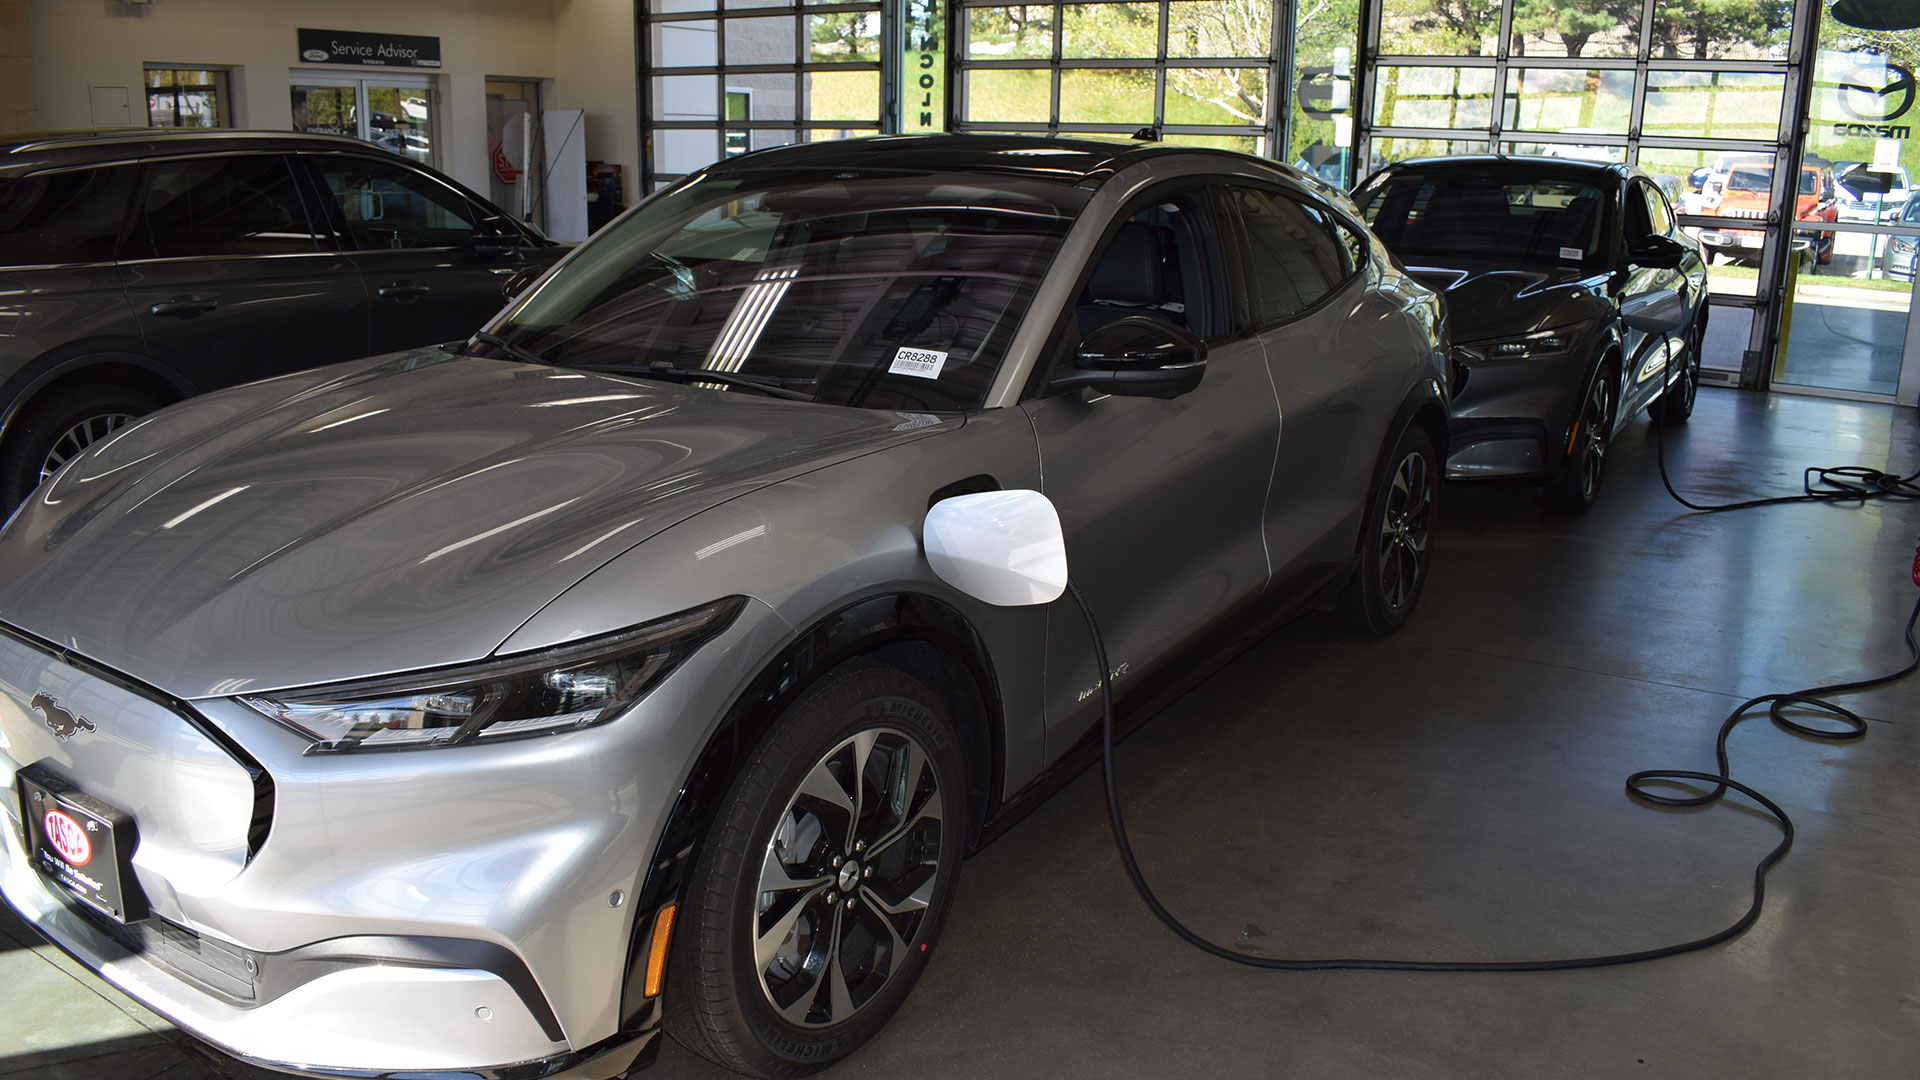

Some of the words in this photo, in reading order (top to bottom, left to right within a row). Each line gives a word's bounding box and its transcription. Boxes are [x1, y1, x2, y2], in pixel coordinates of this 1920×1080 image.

[331, 40, 373, 56] Service
[377, 43, 418, 58] Advisor
[307, 127, 341, 135] ENTRANCE
[897, 350, 938, 364] CR8288
[48, 815, 84, 856] TASCA
